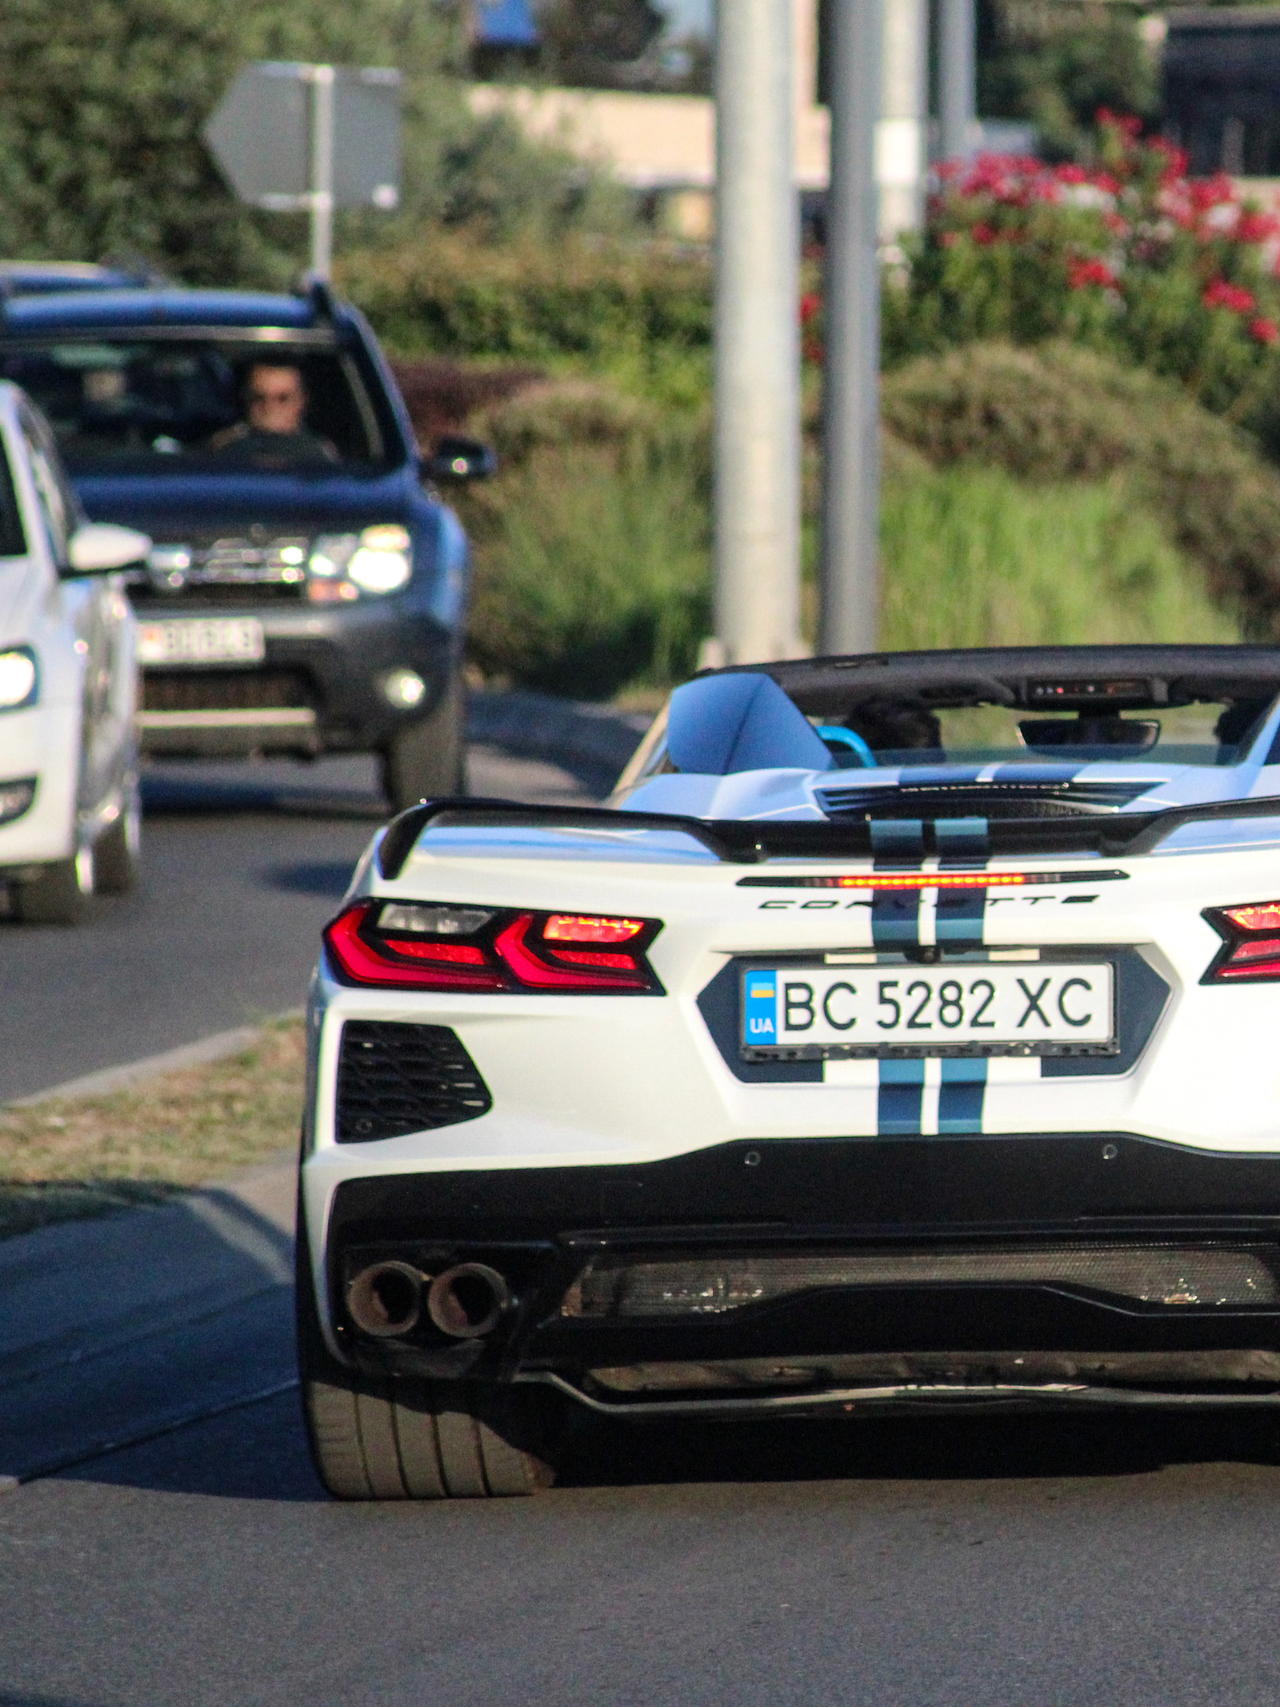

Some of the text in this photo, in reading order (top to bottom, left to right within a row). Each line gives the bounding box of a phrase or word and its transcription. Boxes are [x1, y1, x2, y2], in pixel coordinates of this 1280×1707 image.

[783, 977, 1093, 1032] BC 5282 XC
[750, 1017, 775, 1034] UA
